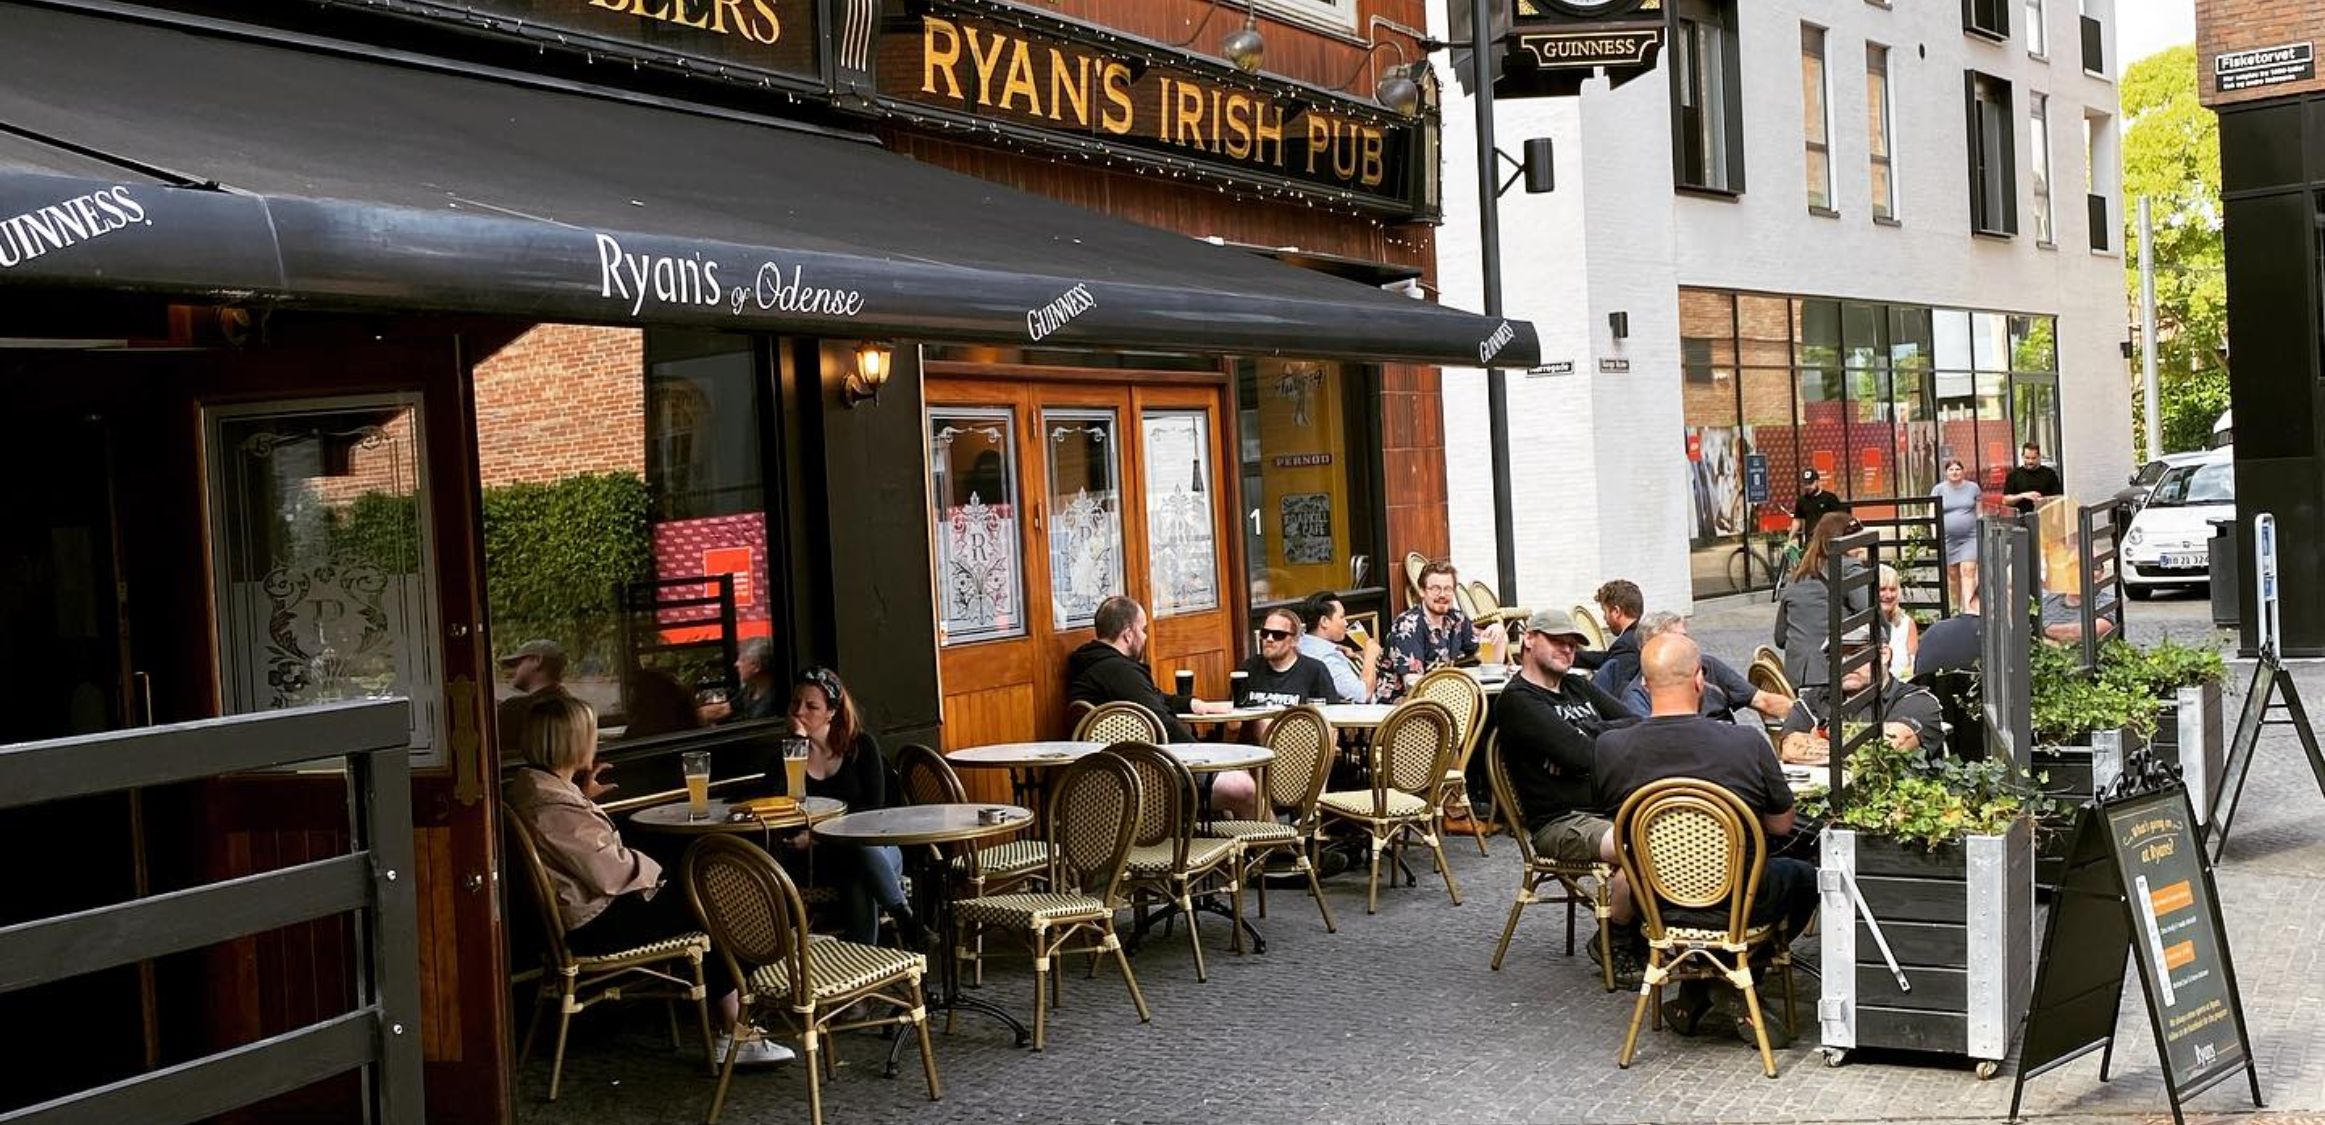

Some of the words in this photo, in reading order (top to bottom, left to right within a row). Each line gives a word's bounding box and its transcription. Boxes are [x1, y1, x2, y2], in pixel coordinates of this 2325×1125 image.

[589, 0, 780, 45] ERS
[1543, 38, 1637, 58] GUINNESS
[2222, 47, 2296, 69] Fisketorvet
[921, 15, 1134, 135] RYAN'S
[1158, 77, 1284, 167] IRISH
[1305, 113, 1383, 187] PUB
[0, 185, 152, 268] UINNESS.
[595, 233, 721, 316] Ryan's
[730, 286, 751, 315] of
[755, 261, 865, 316] Odense
[1276, 454, 1330, 467] PERNOD
[1249, 508, 1263, 536] 1
